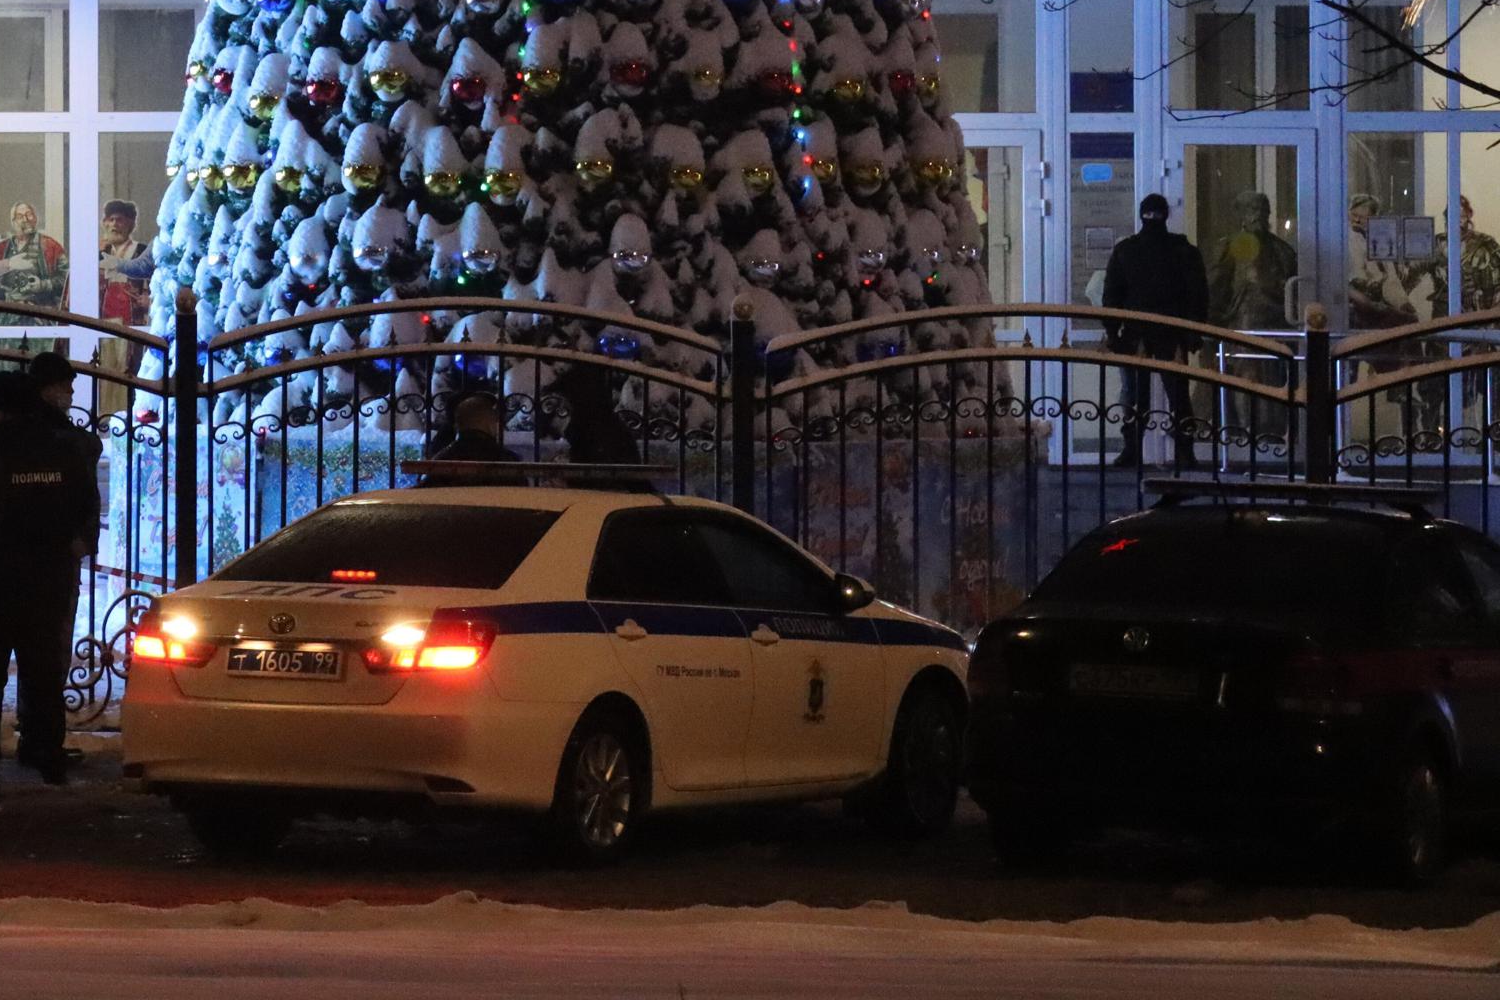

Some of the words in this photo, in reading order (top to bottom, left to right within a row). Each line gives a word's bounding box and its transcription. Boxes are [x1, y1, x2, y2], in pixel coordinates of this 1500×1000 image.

[11, 471, 62, 484] ПОЛИЦИЯ
[221, 585, 396, 600] ДПС
[255, 650, 303, 672] 1605
[315, 653, 334, 668] 99
